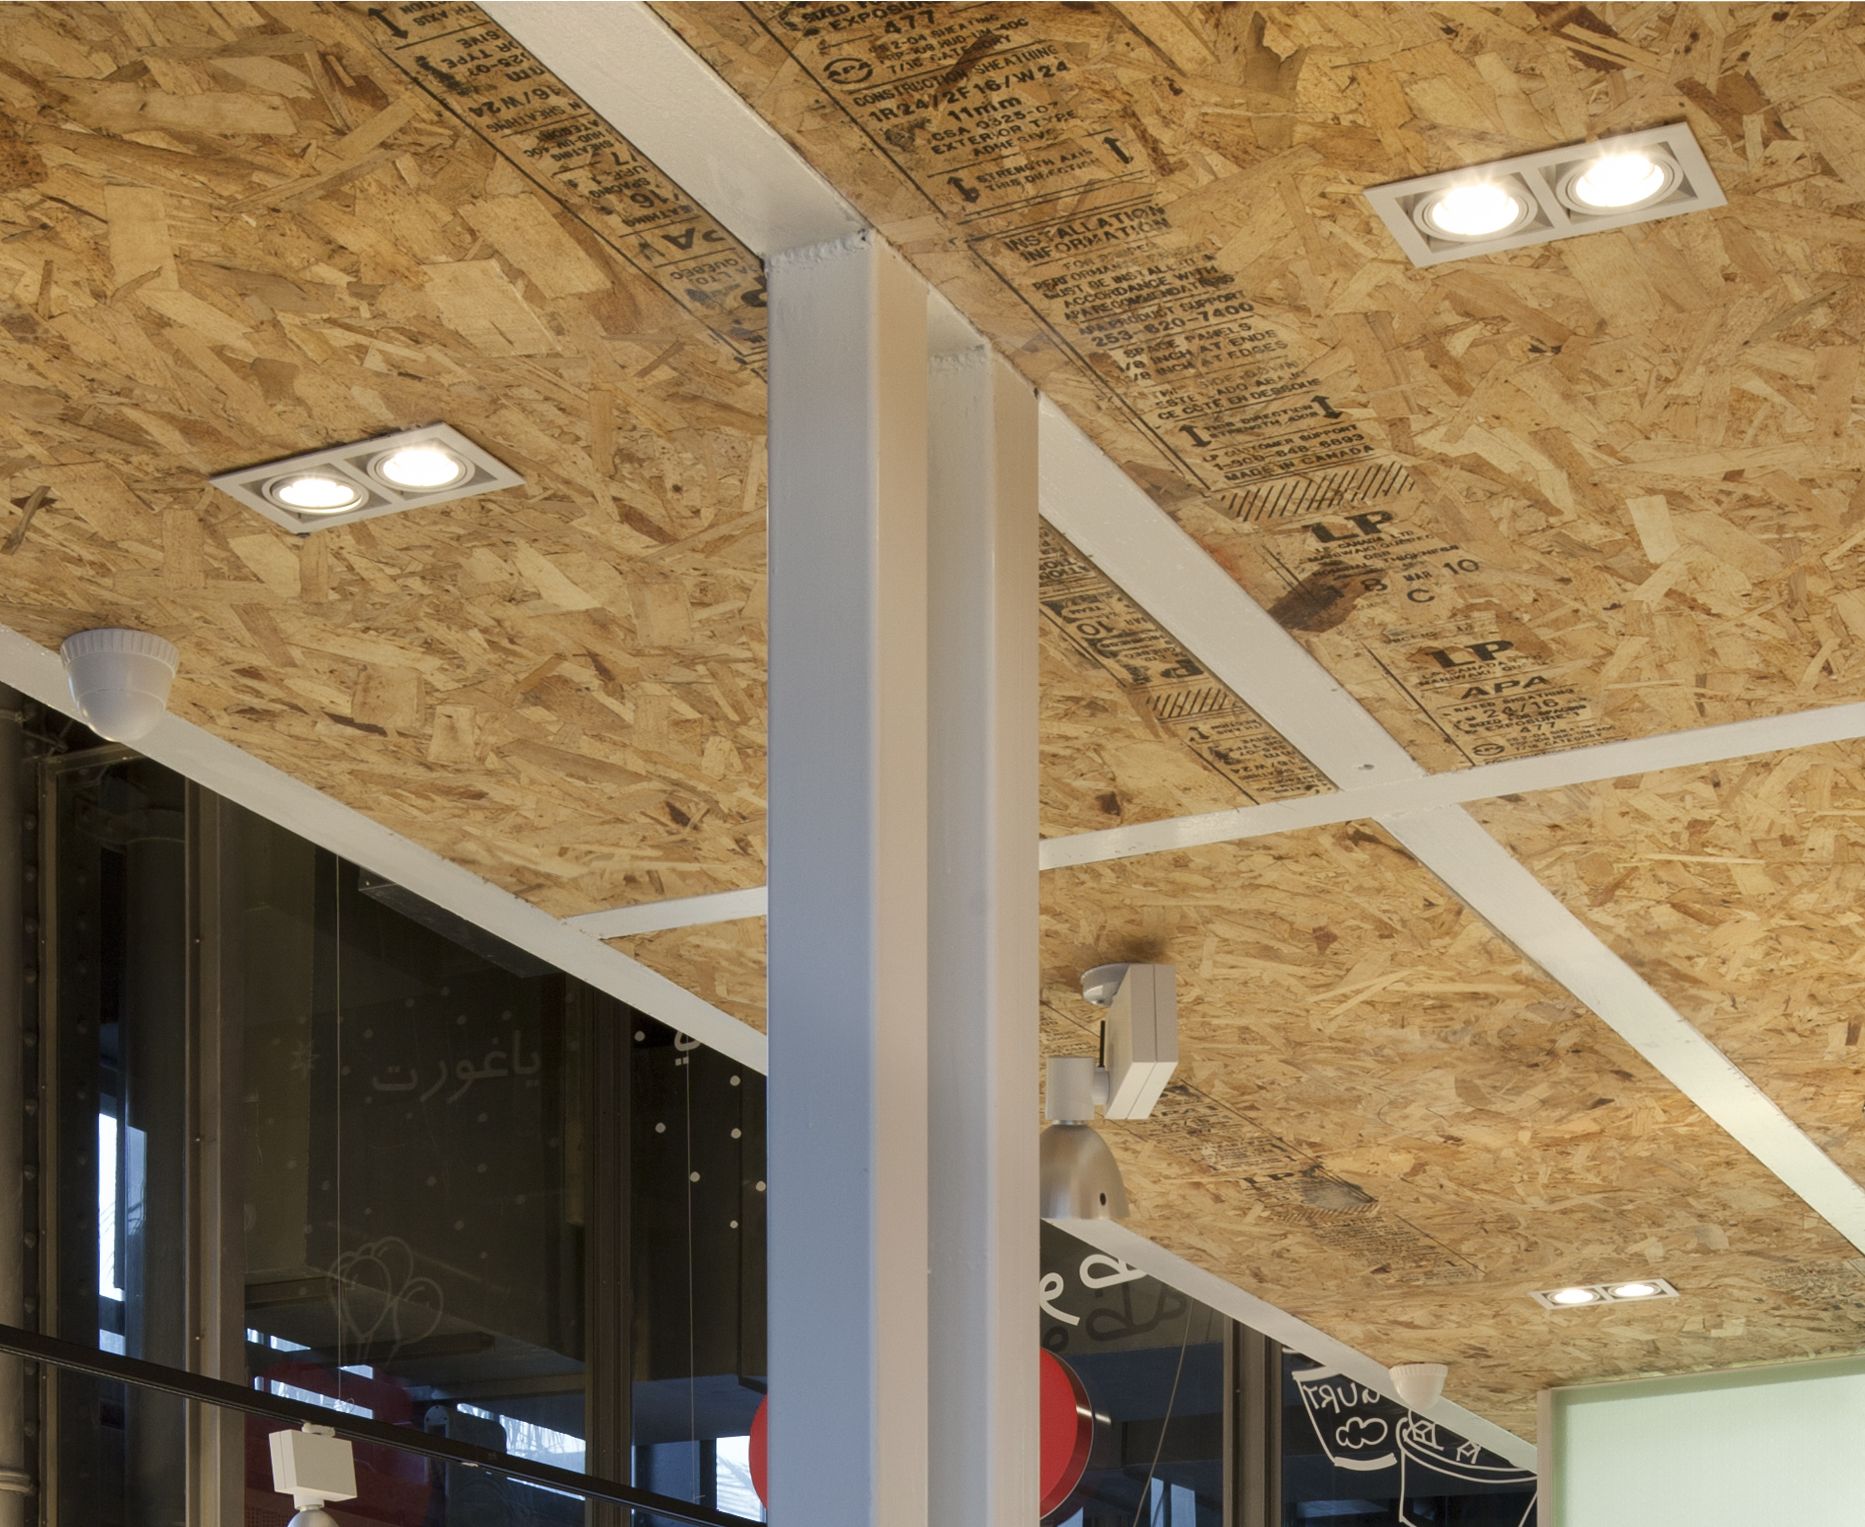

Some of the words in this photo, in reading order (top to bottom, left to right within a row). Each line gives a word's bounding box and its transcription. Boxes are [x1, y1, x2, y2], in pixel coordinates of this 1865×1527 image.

[412, 11, 450, 26] AXIS
[881, 10, 940, 34] 477
[890, 34, 927, 48] 2-04
[929, 34, 1013, 62] CATEGORY
[441, 49, 493, 68] TYPE
[827, 61, 873, 80] APA
[850, 69, 969, 107] CONSTRUCTION
[973, 45, 1058, 74] SHEATHING
[485, 106, 564, 132] SHEATHING
[947, 94, 1022, 121] 11mm
[535, 119, 601, 142] ATEGORY
[930, 125, 971, 141] CSA
[931, 124, 1024, 154] EXTERIOR
[1029, 109, 1078, 128] TYPE
[970, 127, 1059, 156] ADHESIVE
[975, 157, 1055, 184] STRENGTH
[1057, 147, 1094, 162] AXIS
[984, 178, 1021, 192] THIS
[1023, 156, 1102, 183] DIRECTION
[621, 203, 693, 227] EATHING
[1003, 204, 1166, 251] INSTALLATION
[1020, 218, 1172, 261] INFORMATION
[1061, 276, 1171, 308] ACCORDANCE
[1174, 265, 1219, 281] WITH
[1178, 289, 1247, 311] SUPPORT
[1123, 339, 1180, 358] SPACE
[1184, 322, 1252, 343] PANELS
[1149, 348, 1194, 364] INCH
[1196, 341, 1225, 353] AT
[1227, 328, 1277, 346] ENDS
[1155, 361, 1195, 375] INCH
[1197, 354, 1225, 365] AT
[1226, 339, 1288, 359] EDGES
[1156, 409, 1179, 420] CE
[1227, 394, 1248, 404] EN
[1250, 378, 1322, 399] DESSOUS
[1202, 454, 1221, 462] LP
[1298, 423, 1359, 441] SUPPORT
[1224, 466, 1274, 482] MADE
[1277, 461, 1296, 470] IN
[1301, 444, 1374, 465] CANADA
[1302, 510, 1394, 543] LP
[1359, 577, 1387, 591] 8
[1402, 570, 1432, 581] MAR
[1442, 558, 1481, 574] 10
[1404, 588, 1436, 603] C
[1074, 620, 1115, 636] 10
[1427, 639, 1519, 668] LP
[1456, 675, 1549, 699] APA
[1483, 698, 1559, 718] 24/16
[1518, 721, 1558, 733] 477
